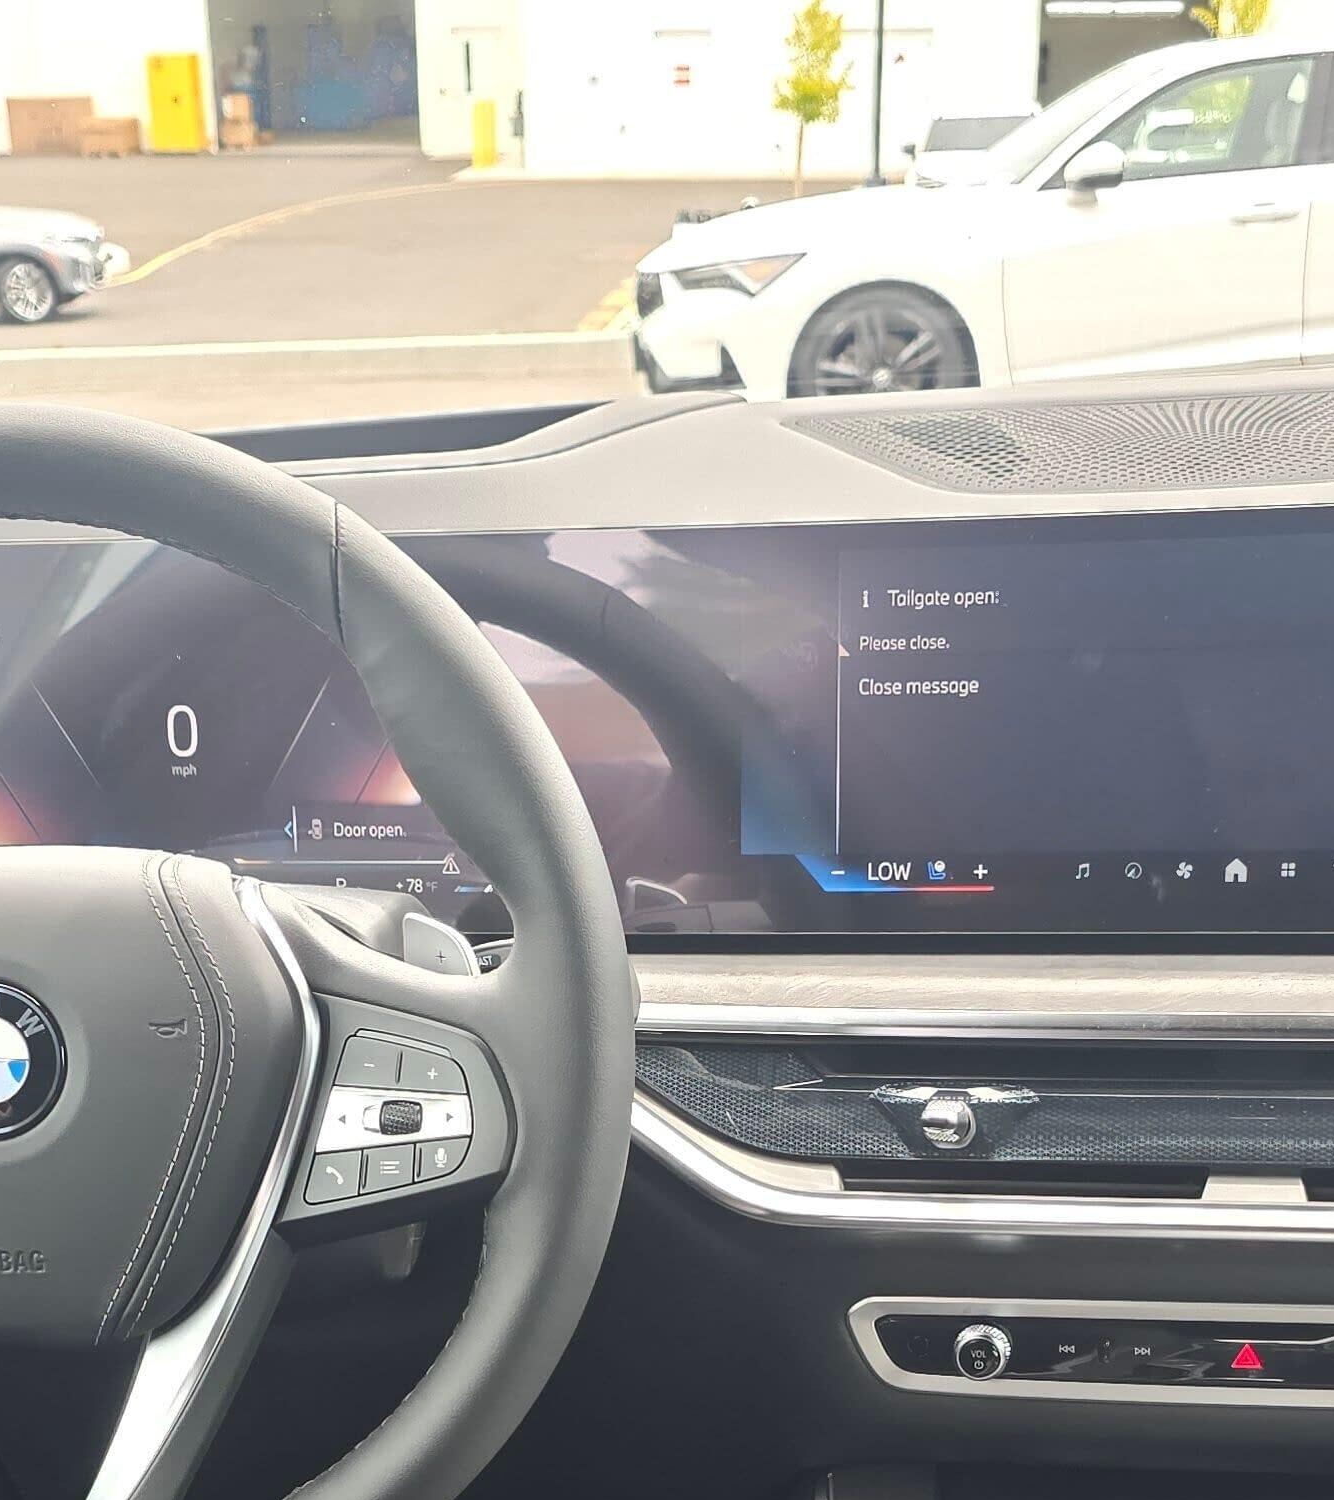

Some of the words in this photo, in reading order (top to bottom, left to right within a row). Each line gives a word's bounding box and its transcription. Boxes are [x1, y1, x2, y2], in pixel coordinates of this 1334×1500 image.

[887, 589, 950, 609] Tailgate
[859, 636, 906, 650] Please
[910, 635, 950, 650] close.
[859, 678, 902, 695] Close
[906, 679, 979, 697] message
[166, 704, 199, 758] 0
[171, 764, 198, 779] mph
[333, 822, 367, 837] Door
[867, 862, 911, 881] LOW
[971, 1350, 987, 1358] VOL
